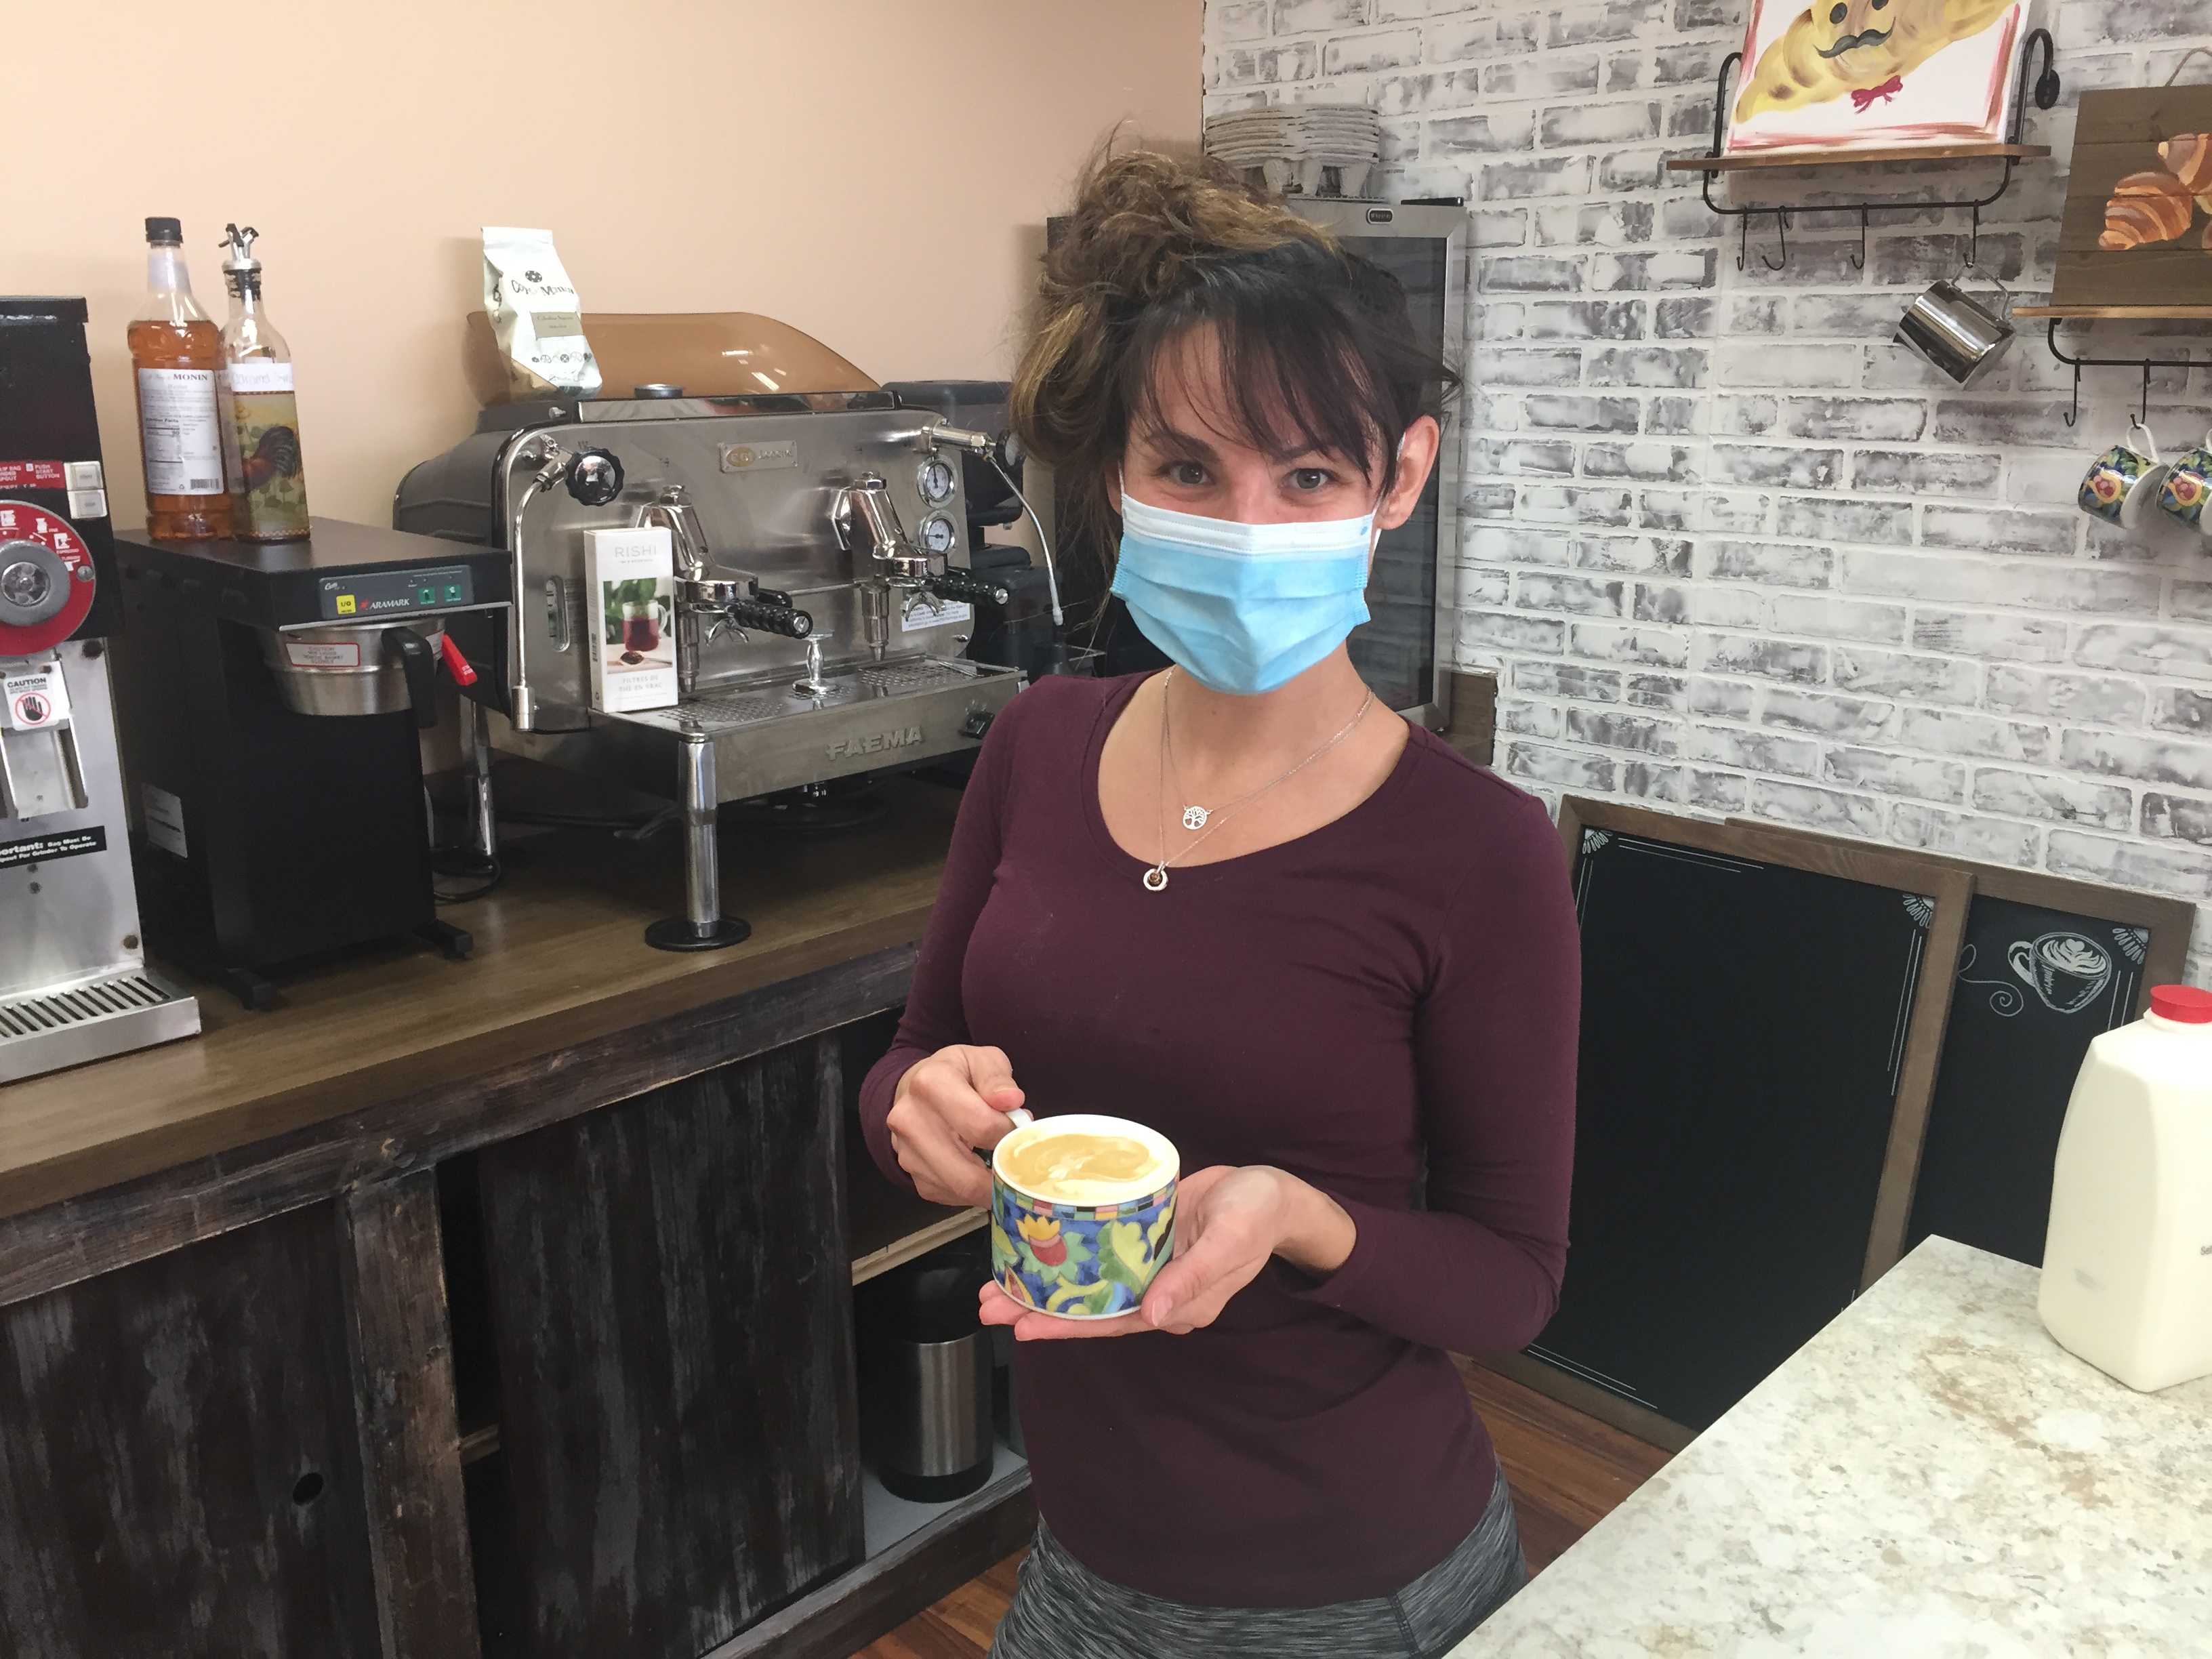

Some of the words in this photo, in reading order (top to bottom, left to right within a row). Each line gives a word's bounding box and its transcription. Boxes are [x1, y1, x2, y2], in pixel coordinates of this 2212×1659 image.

[615, 545, 656, 558] RISHI
[370, 598, 410, 610] ARAMARK
[7, 677, 47, 688] CAUTION
[825, 725, 923, 761] FAEMA
[0, 842, 43, 856] ortant:
[32, 848, 58, 857] Grinder
[69, 842, 97, 850] Operate
